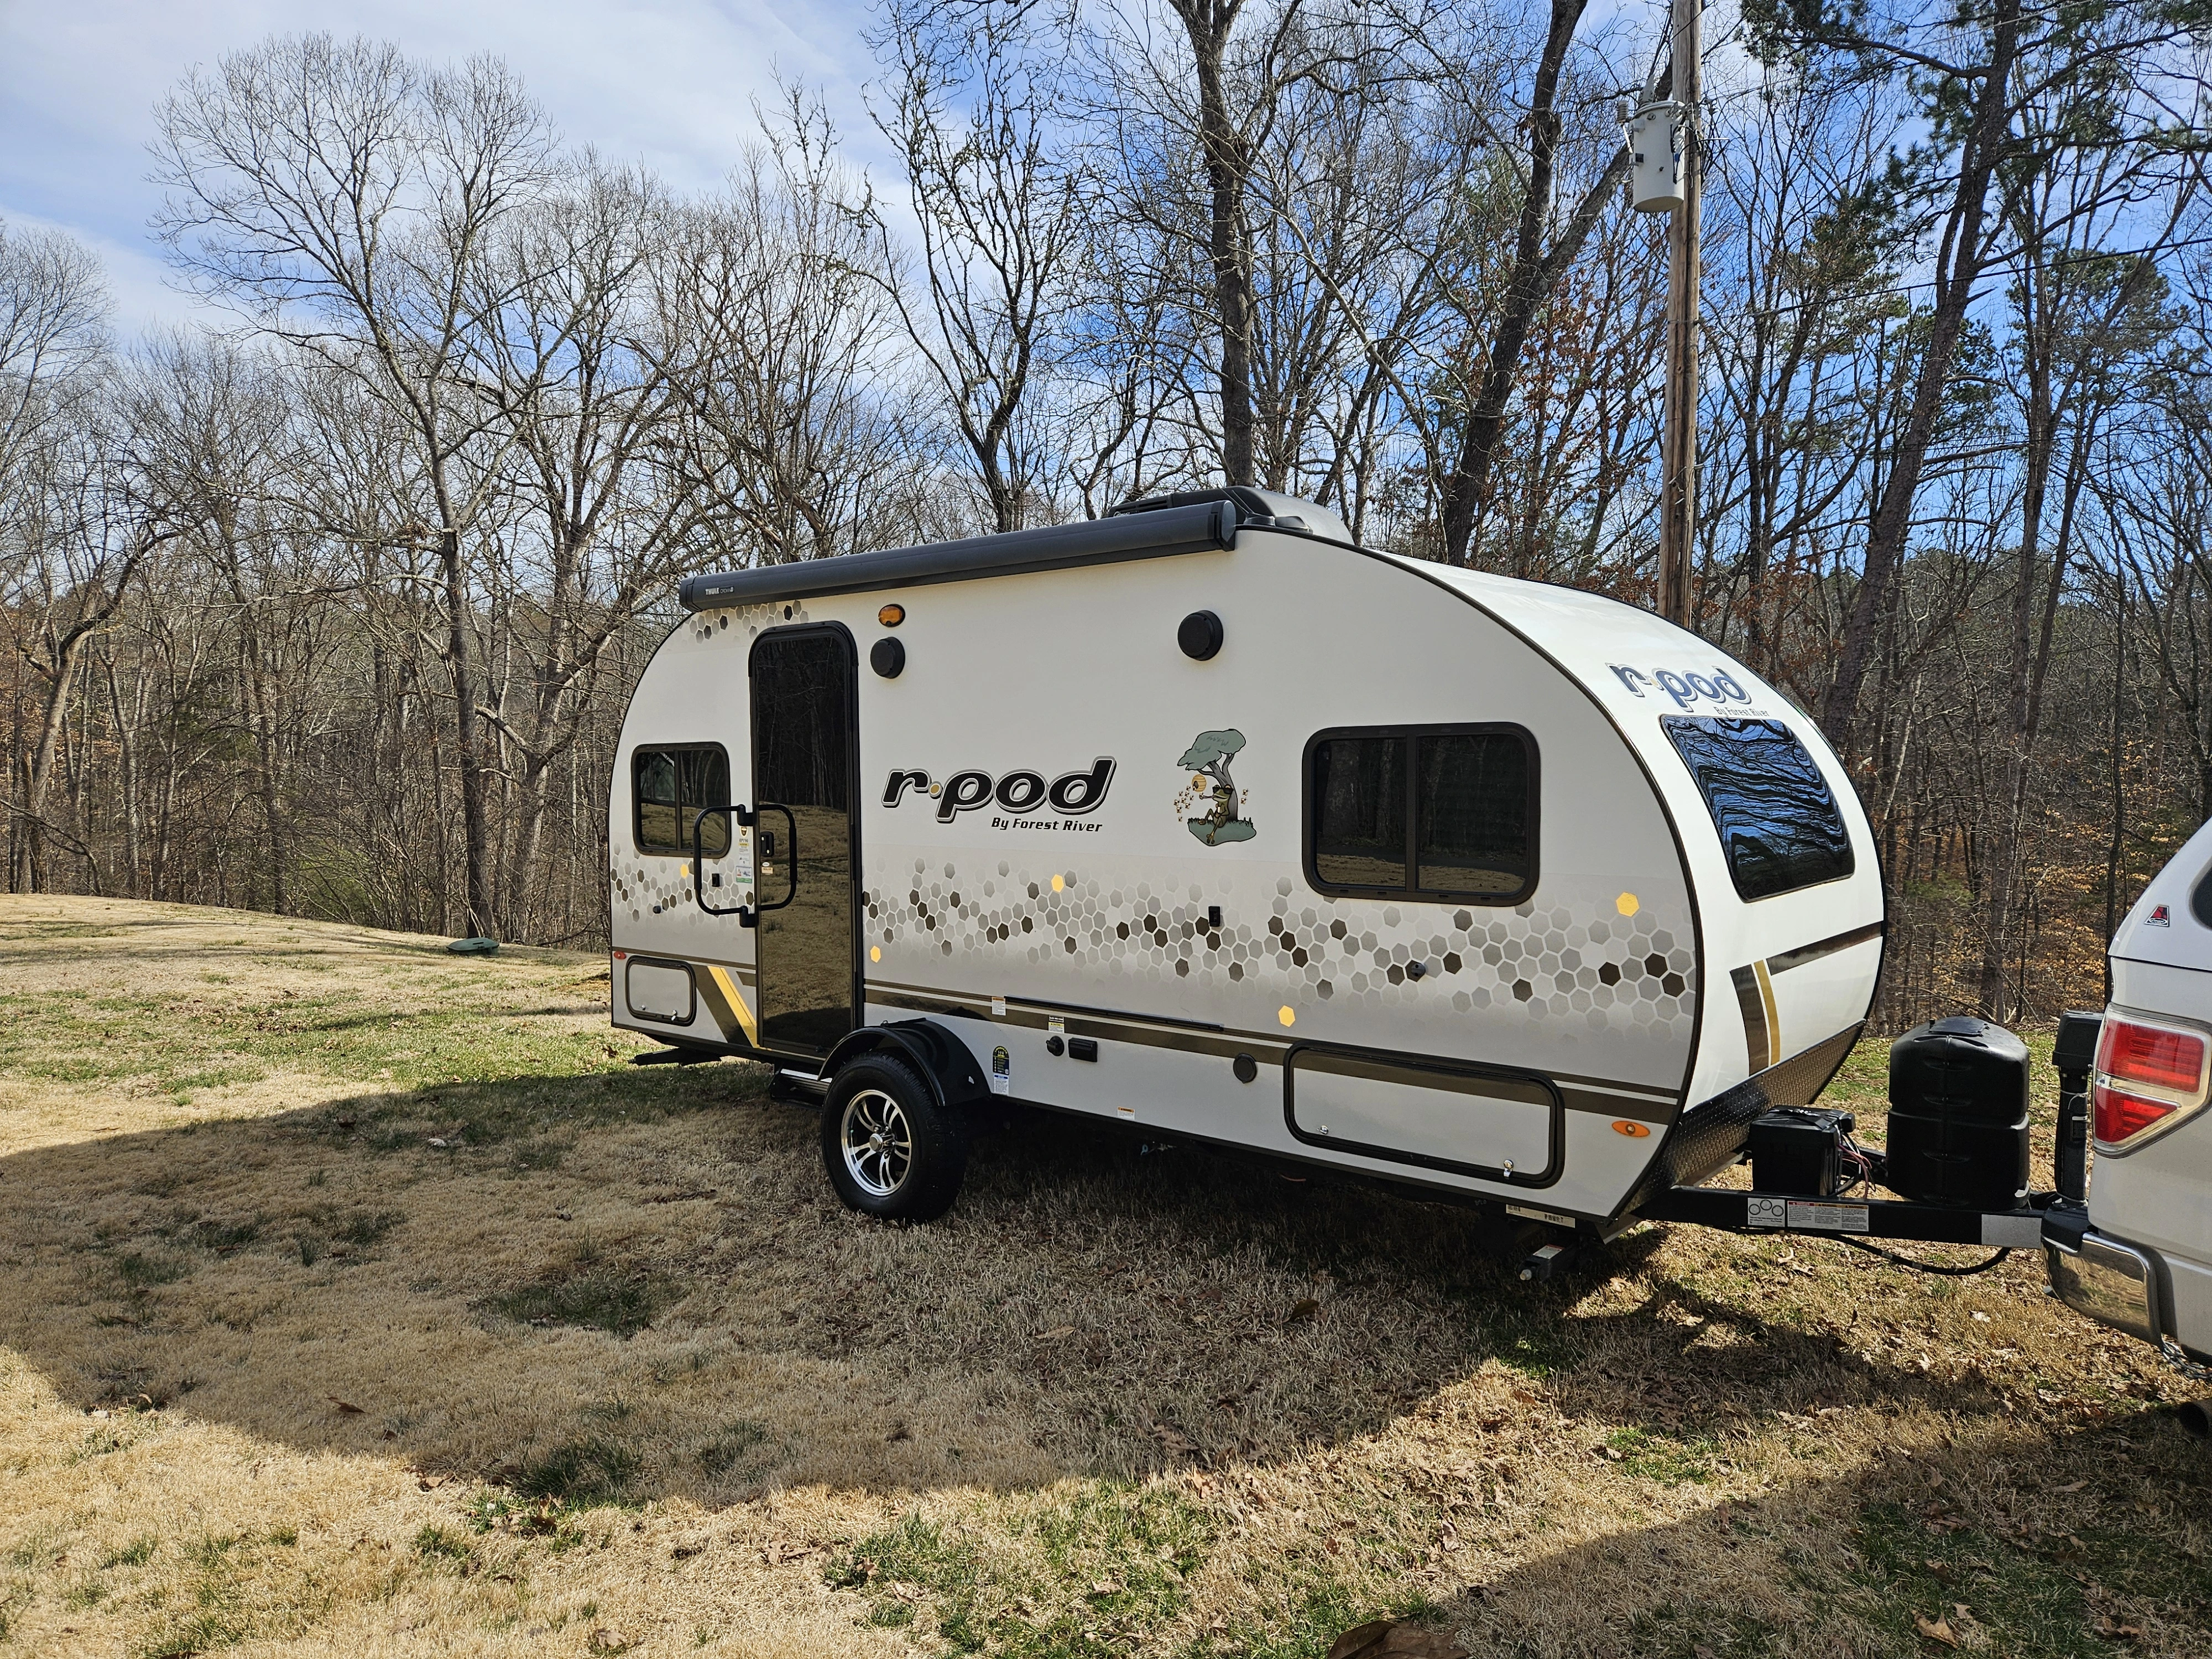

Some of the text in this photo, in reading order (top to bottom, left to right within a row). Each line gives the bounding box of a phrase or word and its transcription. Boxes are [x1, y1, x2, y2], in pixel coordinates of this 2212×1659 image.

[1713, 706, 1770, 717] By Forest River
[991, 817, 1103, 832] By Forest River
